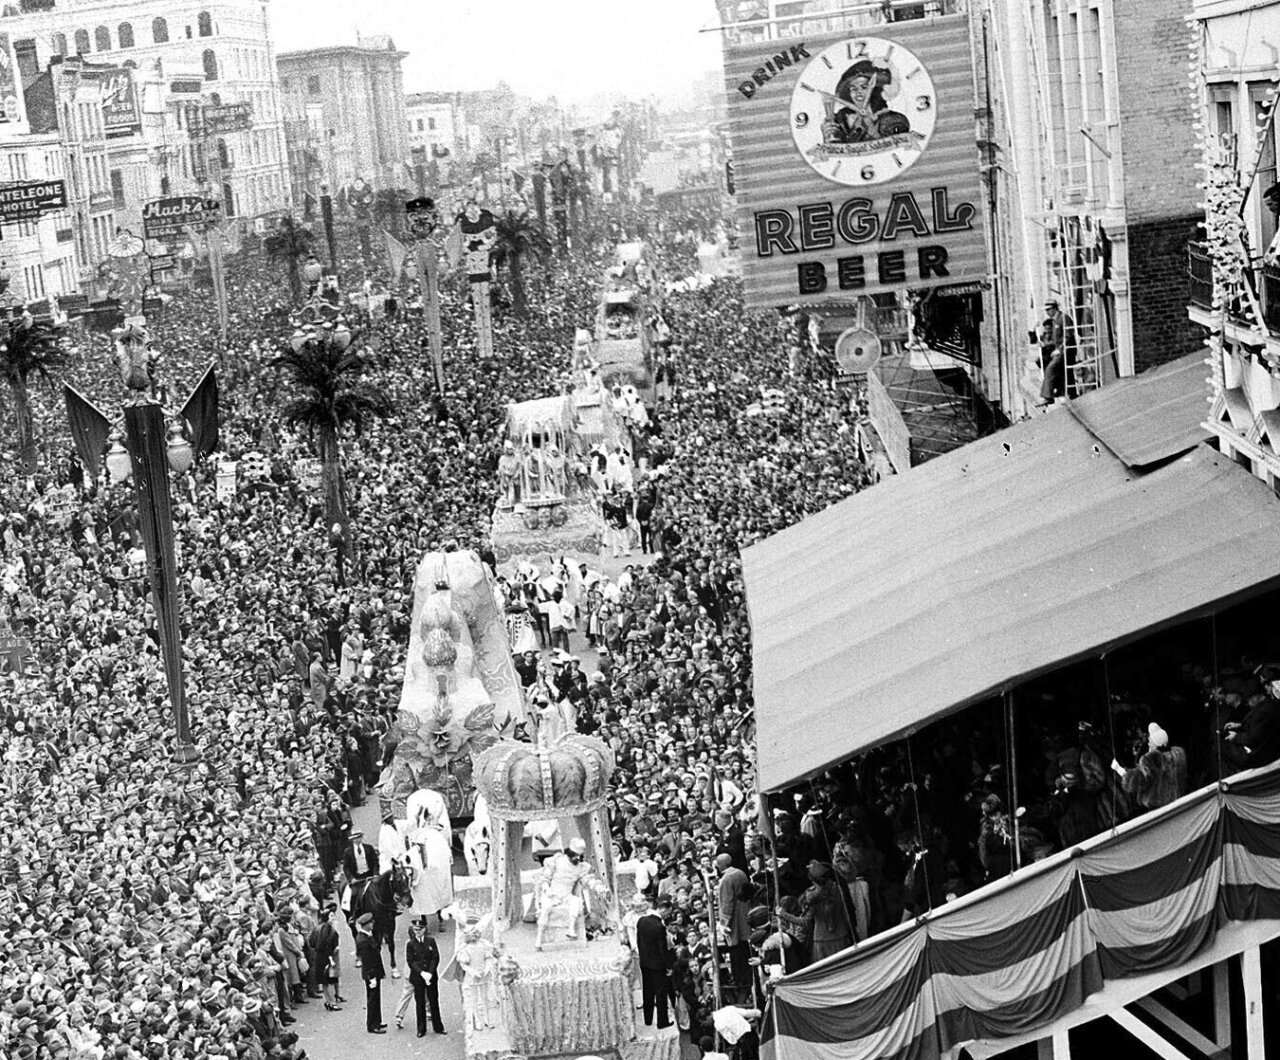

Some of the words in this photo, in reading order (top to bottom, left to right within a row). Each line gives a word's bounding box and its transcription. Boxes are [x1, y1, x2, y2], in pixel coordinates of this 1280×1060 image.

[847, 41, 869, 60] 12
[738, 43, 811, 99] DRINK
[915, 94, 932, 112] 3
[794, 111, 809, 129] 9
[860, 164, 876, 181] 6
[2, 200, 39, 213] HOTEL
[143, 198, 203, 219] Mack's
[753, 186, 977, 258] REGAL
[798, 244, 950, 295] BEER
[6, 639, 23, 649] AGE
